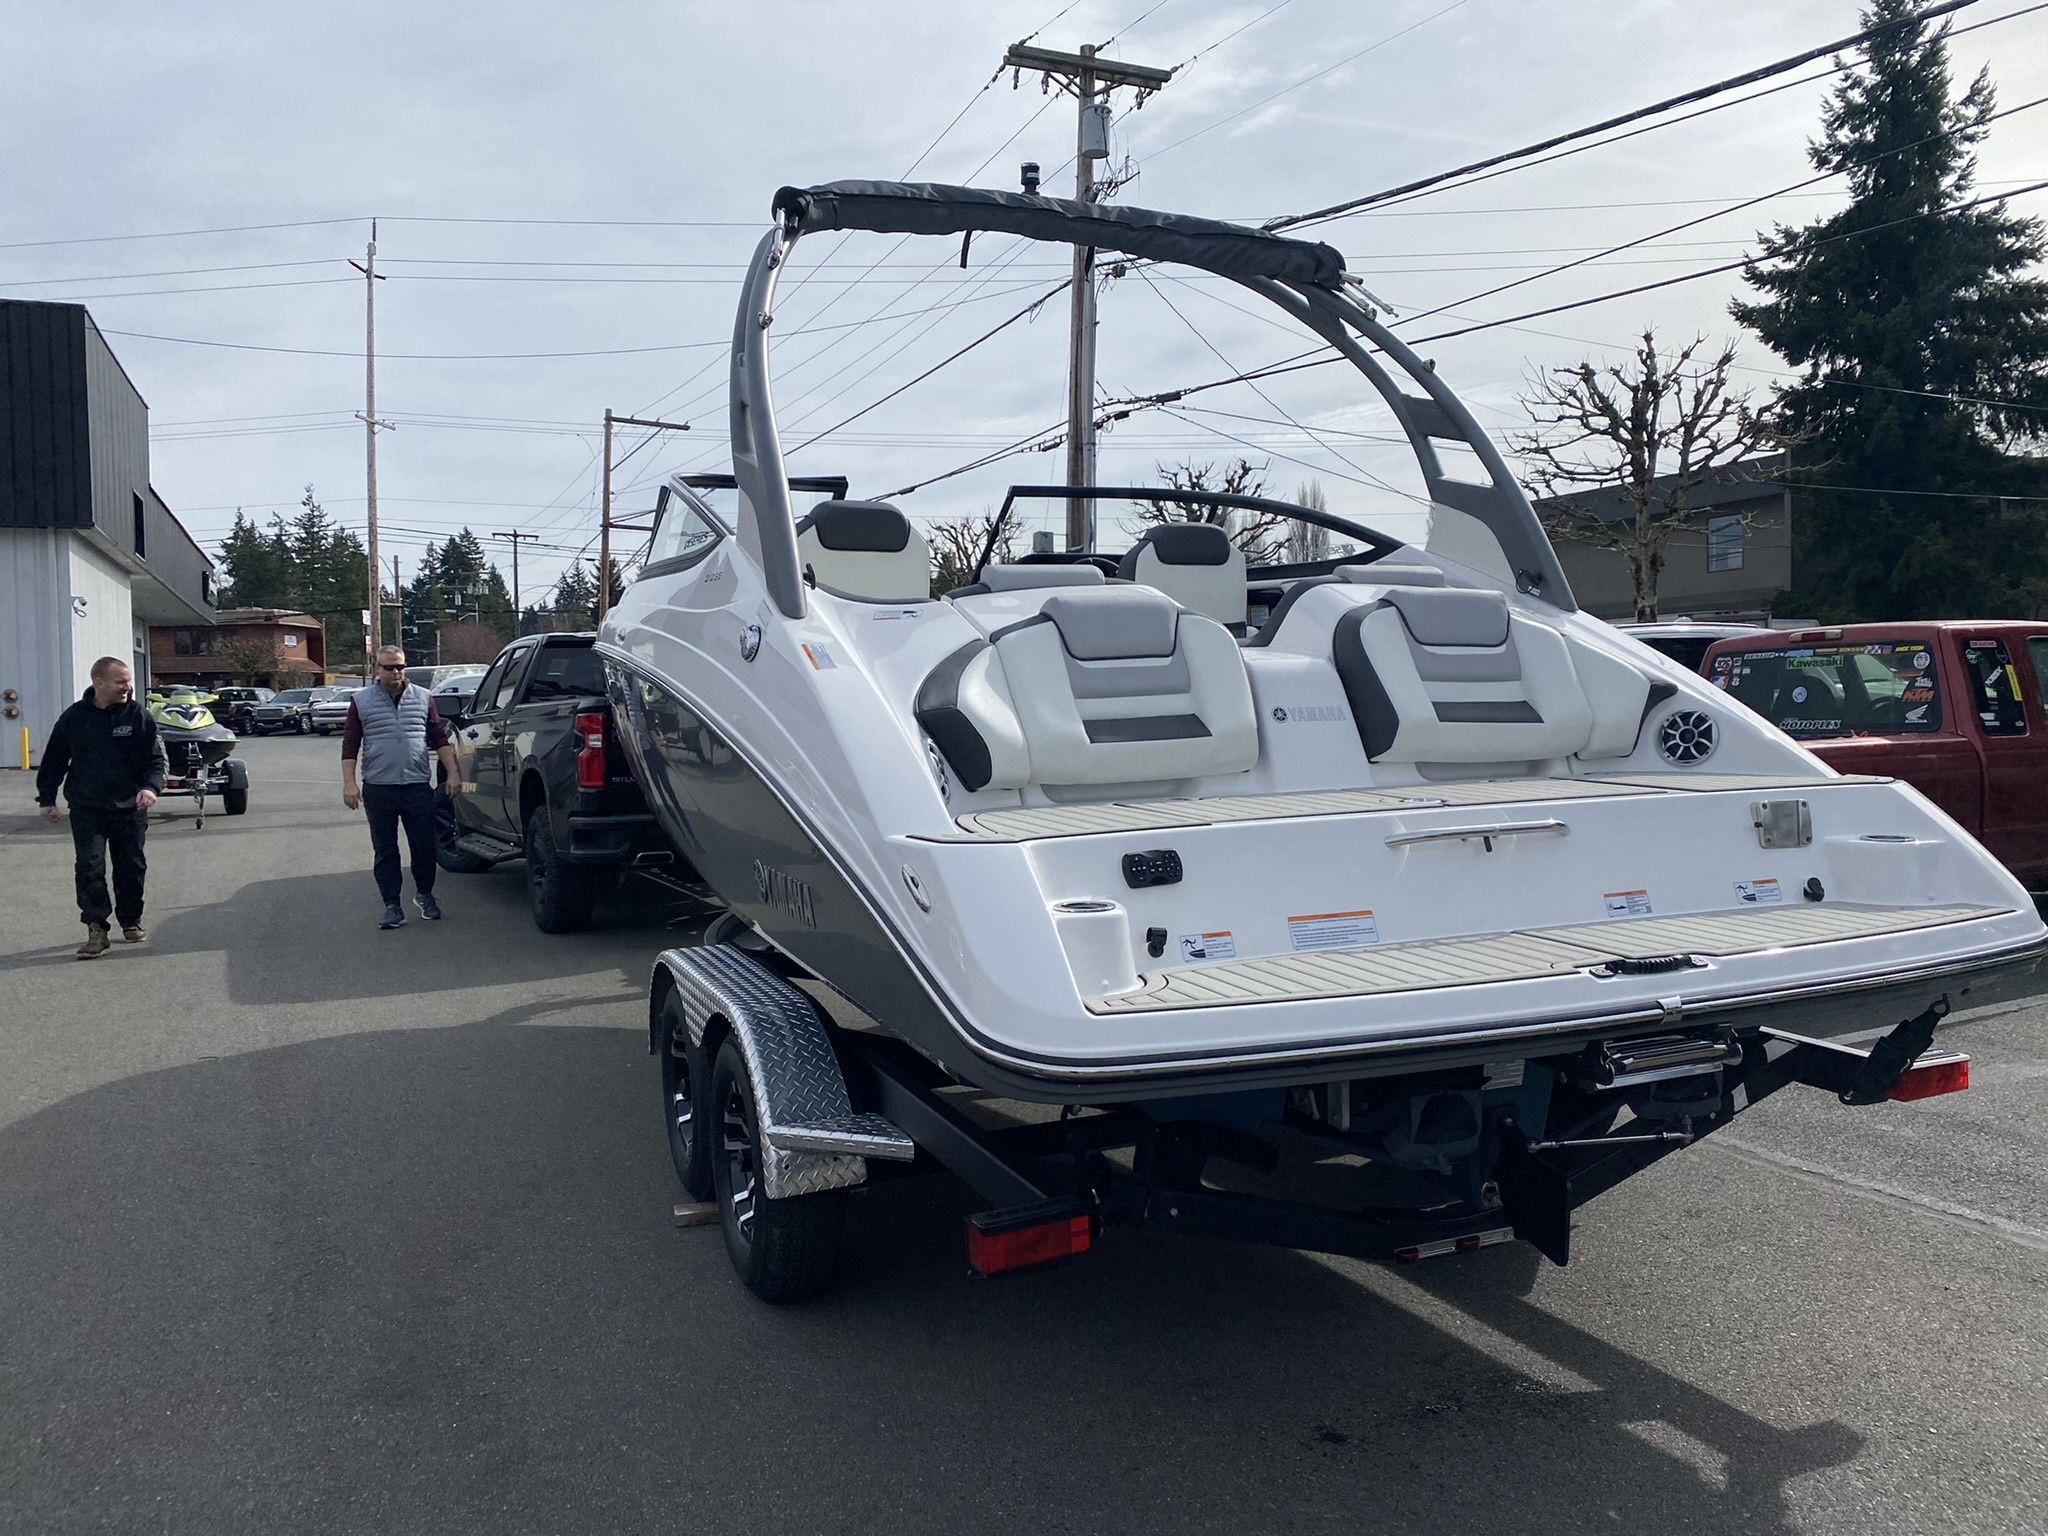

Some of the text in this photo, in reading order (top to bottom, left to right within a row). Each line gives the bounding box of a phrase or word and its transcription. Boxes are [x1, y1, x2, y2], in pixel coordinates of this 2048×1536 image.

[1788, 656, 1843, 668] Kawasaki
[1287, 705, 1346, 722] YAMAHA
[763, 864, 817, 930] YAMAHA
